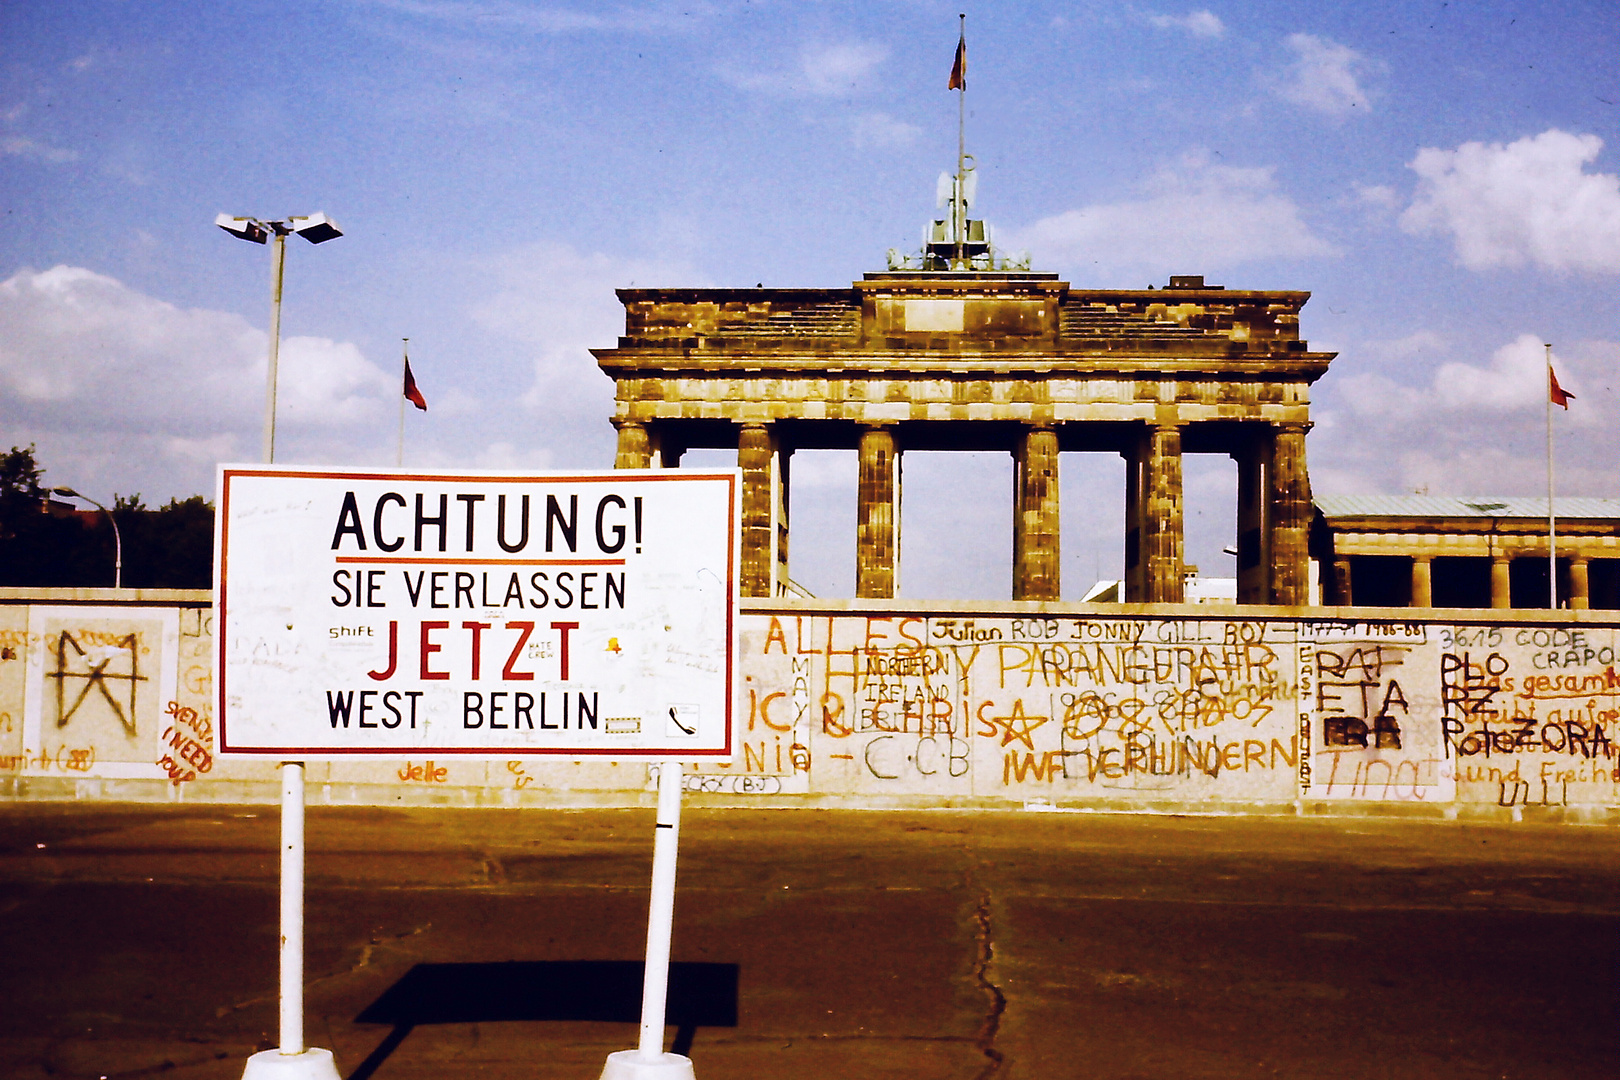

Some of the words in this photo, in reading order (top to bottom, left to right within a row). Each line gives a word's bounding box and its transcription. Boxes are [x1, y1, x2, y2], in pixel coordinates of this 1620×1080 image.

[331, 491, 643, 555] ACHTUNG!
[331, 569, 387, 608] SIE
[403, 570, 626, 610] VERLASSEN
[367, 620, 579, 681] JETZT
[764, 616, 923, 657] ALLES
[1532, 646, 1620, 671] CRAPO
[326, 690, 424, 730] WEST
[463, 691, 599, 730] BERLIN
[1316, 678, 1409, 719] ETA
